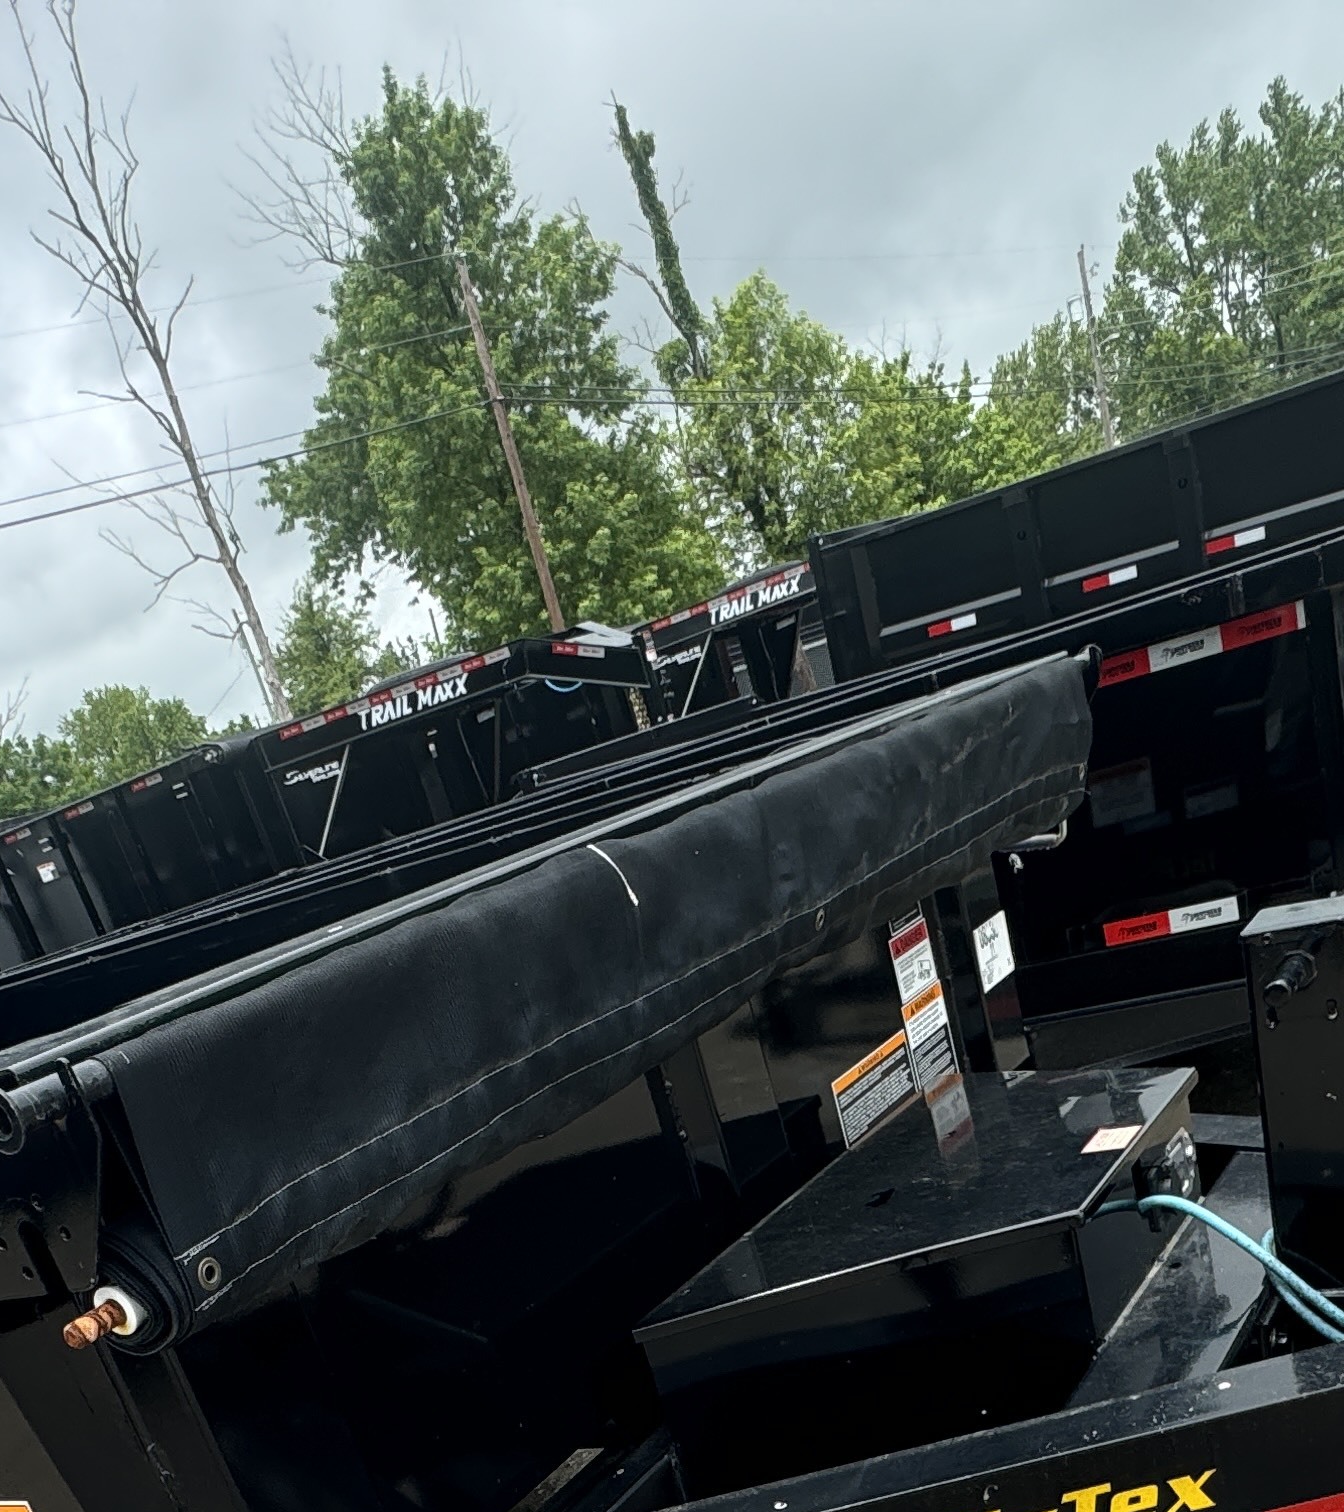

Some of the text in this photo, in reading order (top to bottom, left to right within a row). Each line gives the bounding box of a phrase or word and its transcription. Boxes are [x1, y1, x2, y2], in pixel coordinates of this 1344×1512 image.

[709, 593, 754, 625] TRAIL
[758, 573, 802, 607] MAXX
[357, 694, 413, 731] TRAIL
[416, 672, 468, 711] MAXX
